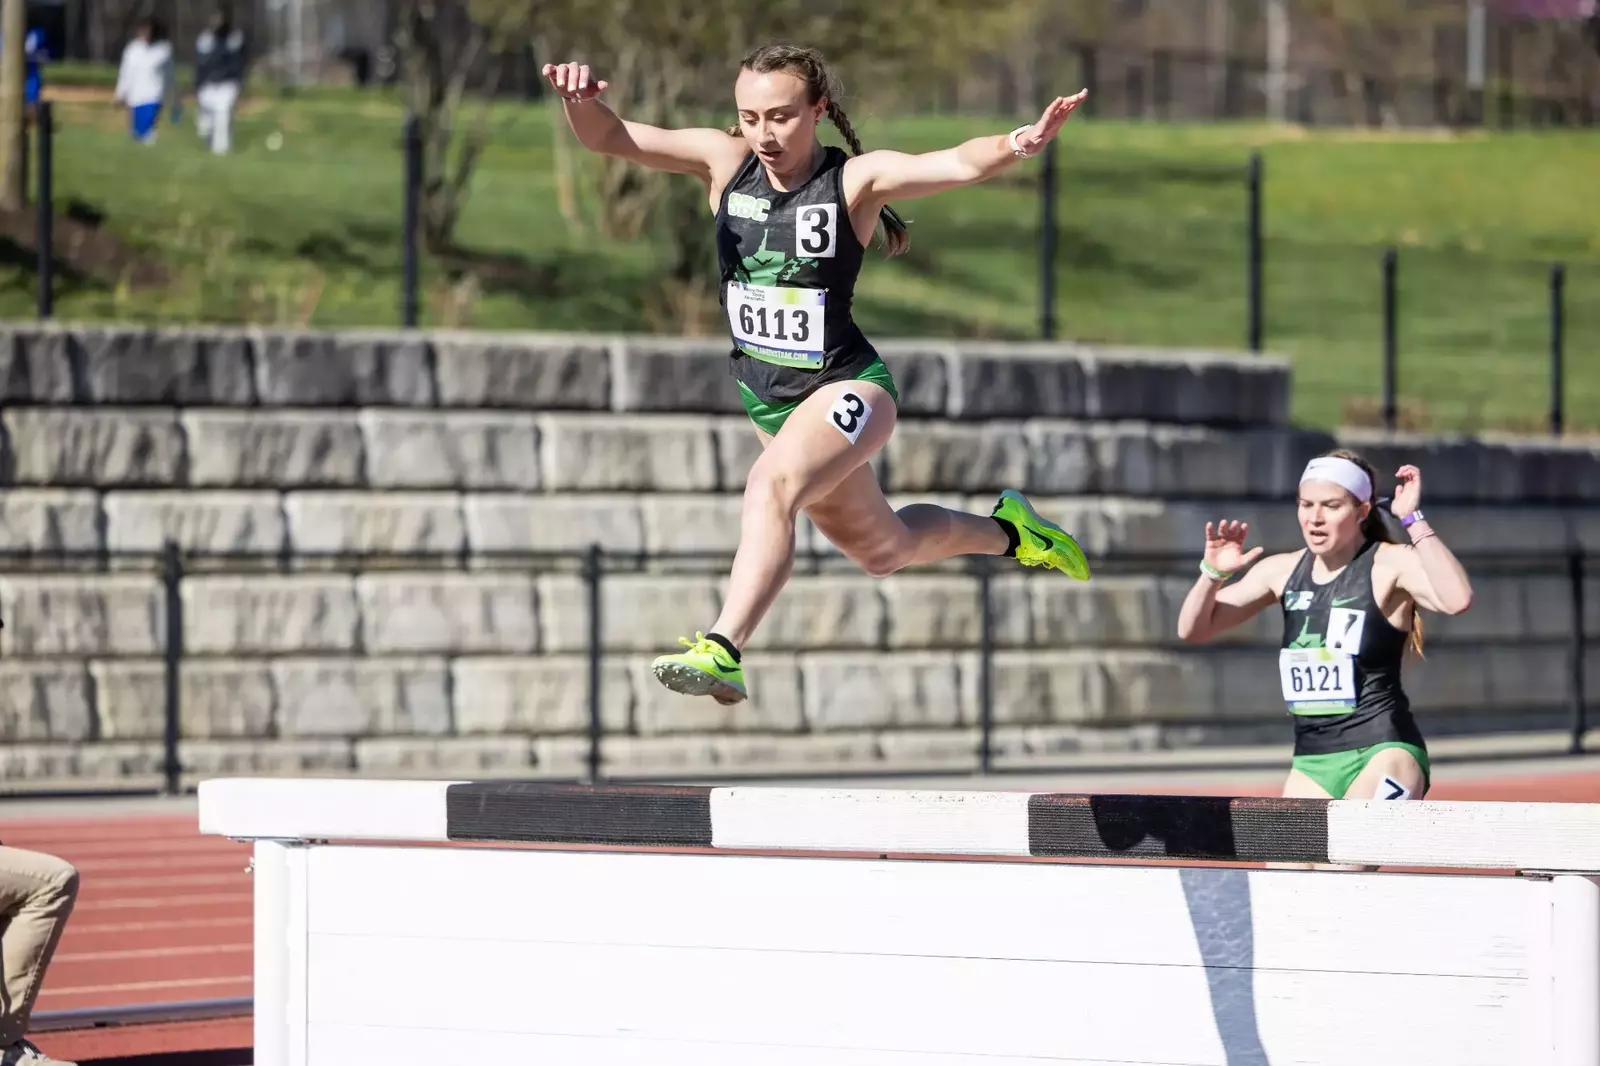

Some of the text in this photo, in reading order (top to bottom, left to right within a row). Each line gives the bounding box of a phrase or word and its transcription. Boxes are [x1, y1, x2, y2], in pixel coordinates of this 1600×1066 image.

[800, 207, 830, 254] 3
[739, 303, 809, 342] 6113
[832, 393, 865, 433] 3
[1290, 665, 1342, 692] 6121
